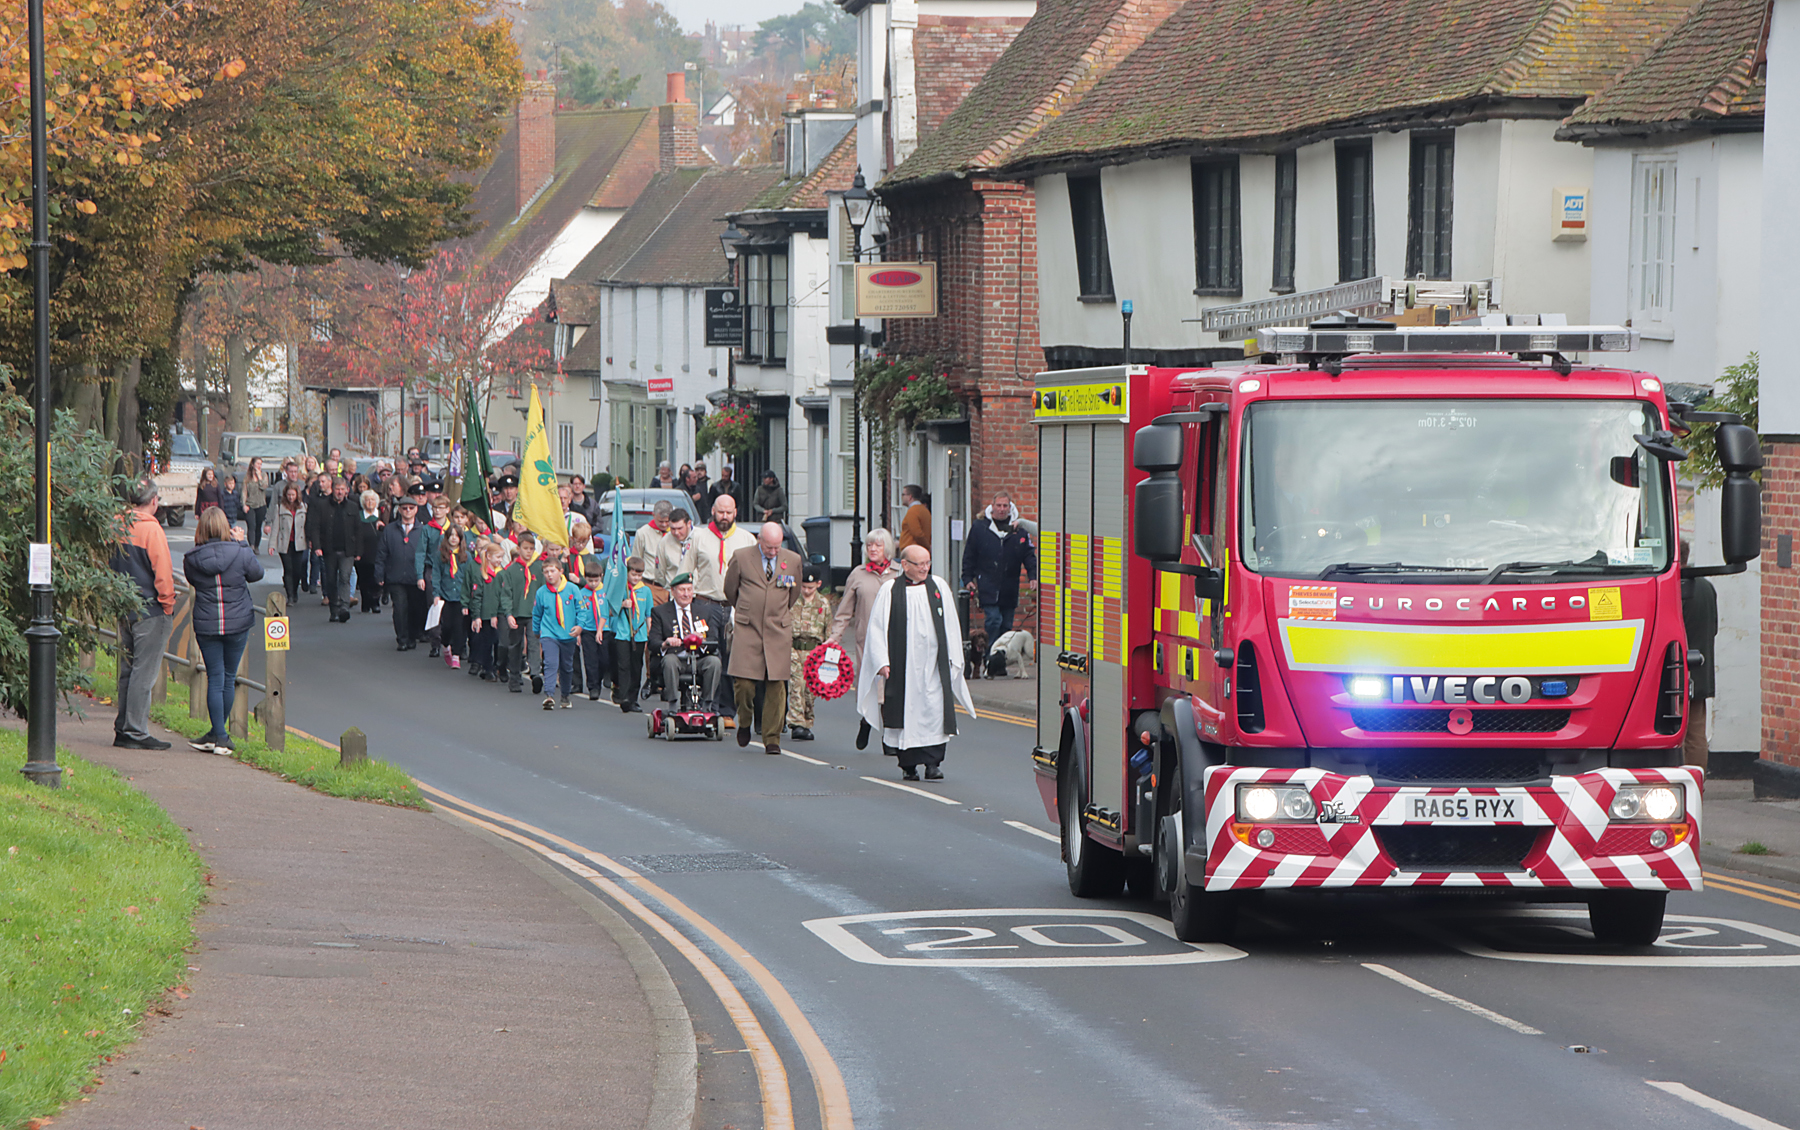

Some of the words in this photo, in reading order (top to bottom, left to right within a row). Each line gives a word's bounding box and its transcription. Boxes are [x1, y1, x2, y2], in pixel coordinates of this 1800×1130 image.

[1564, 198, 1584, 209] ADT
[1339, 596, 1586, 611] EUROCARGO
[270, 625, 284, 634] 20
[1392, 676, 1532, 704] IVECO
[1414, 798, 1469, 818] RA65
[1475, 798, 1515, 818] RYX
[881, 923, 1147, 952] 20
